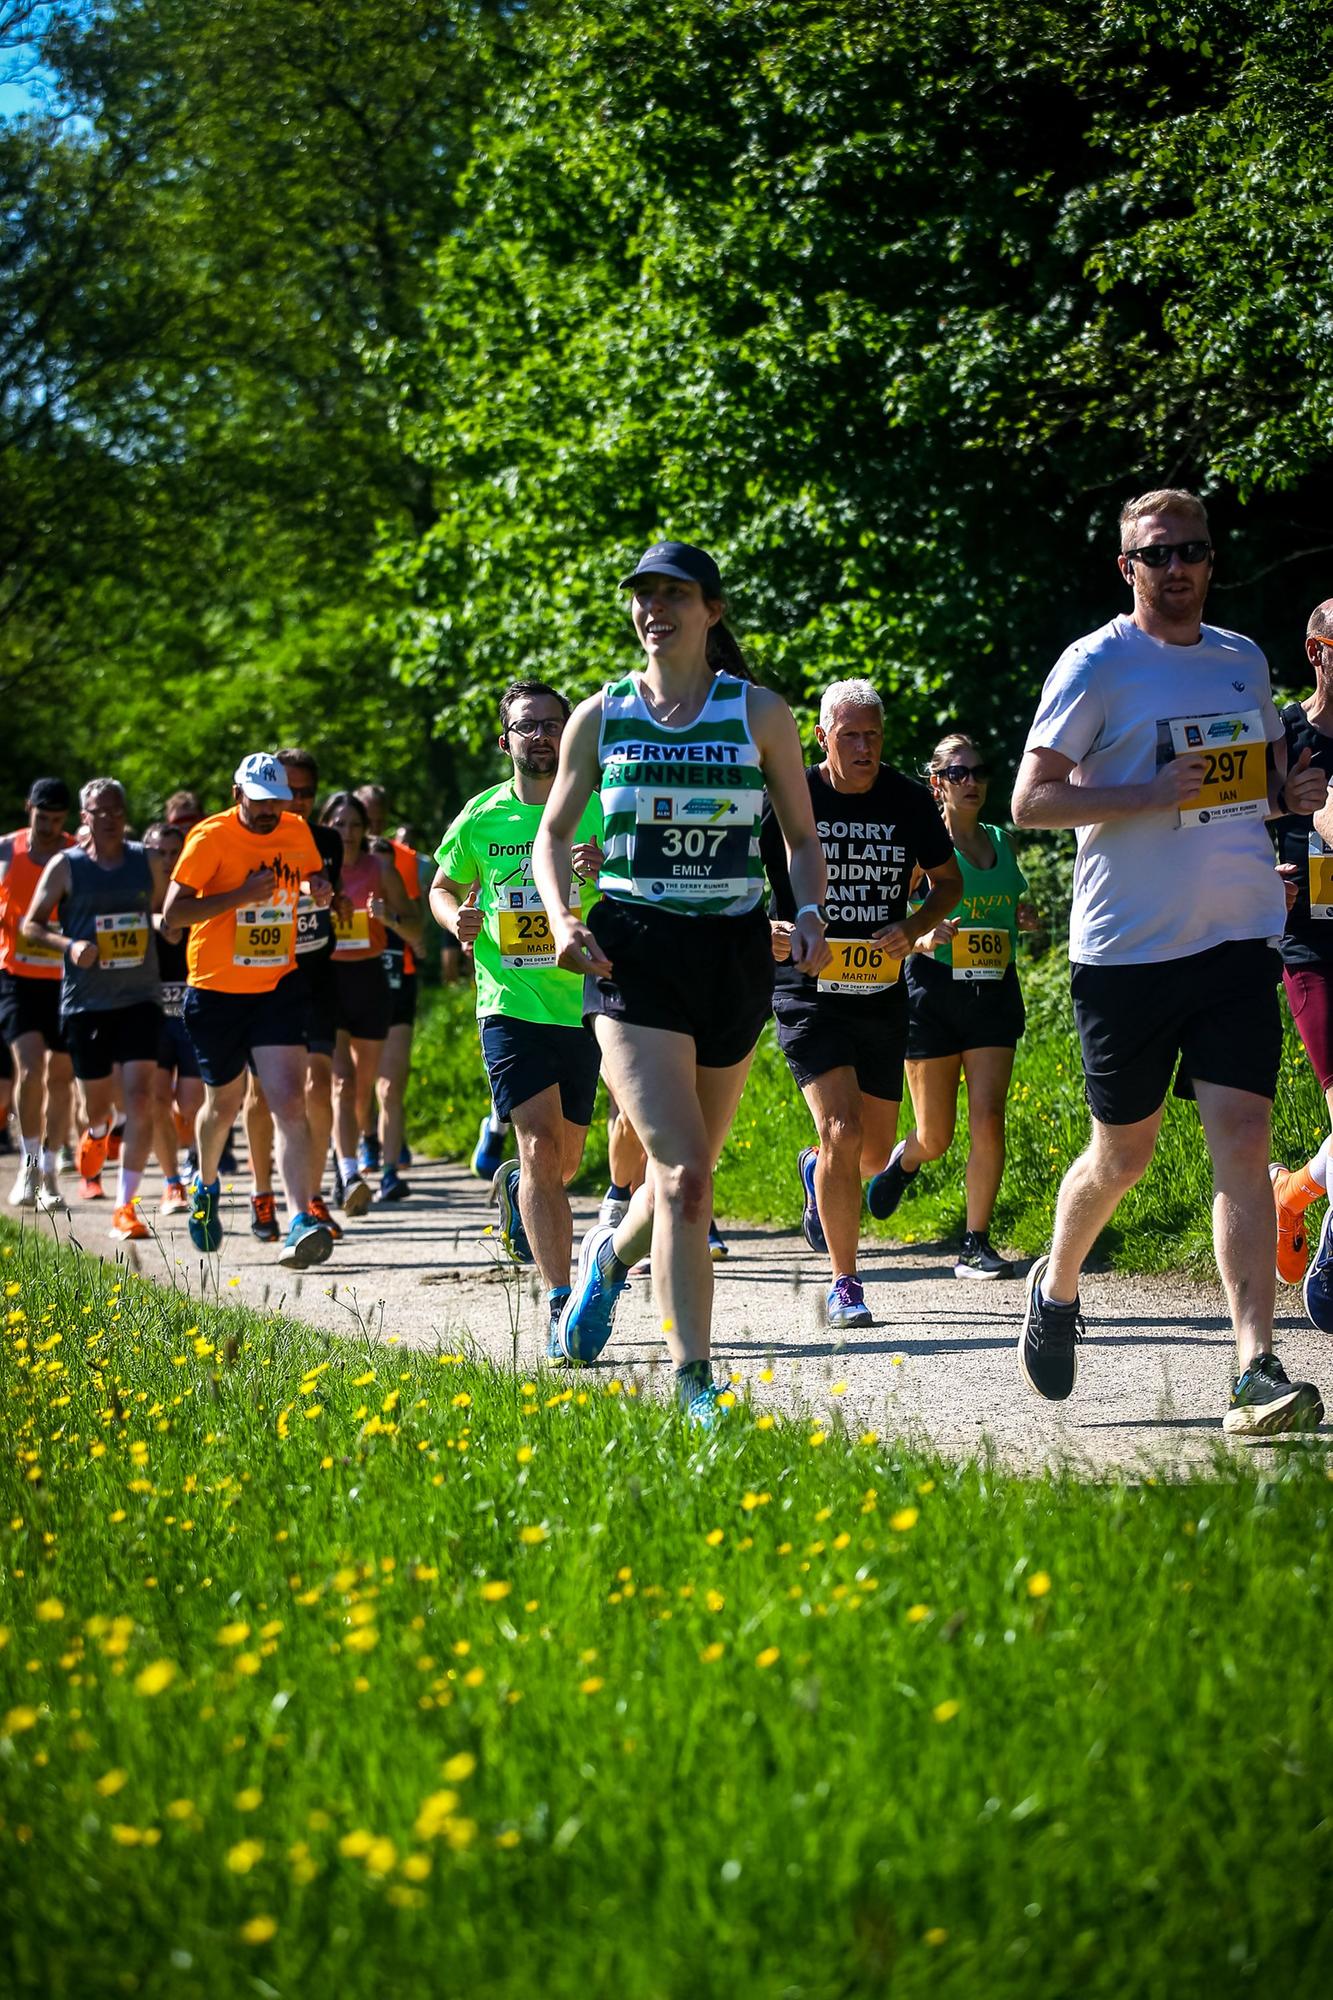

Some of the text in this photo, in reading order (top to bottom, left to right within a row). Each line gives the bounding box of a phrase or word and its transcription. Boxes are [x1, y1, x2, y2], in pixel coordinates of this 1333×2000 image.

[608, 765, 742, 785] RUNNERS
[1202, 750, 1248, 785] 297
[1219, 789, 1237, 801] IAN
[1222, 807, 1239, 815] DERBY
[816, 821, 896, 841] SORRY
[488, 840, 534, 857] Dronf
[661, 828, 728, 857] 307
[847, 843, 906, 863] LATE
[672, 864, 713, 876] EMILY
[826, 864, 903, 882] DIDN'T
[703, 882, 730, 890] RUNNER
[825, 884, 902, 902] ANT TO
[825, 904, 889, 922] COME
[297, 913, 319, 932] 64
[517, 915, 549, 939] 23
[111, 932, 138, 948] 174
[248, 927, 281, 946] 509
[968, 934, 1002, 954] 568
[527, 943, 556, 953] MARK
[841, 946, 883, 968] 106
[841, 972, 877, 981] MARTIN
[161, 986, 184, 1002] 32
